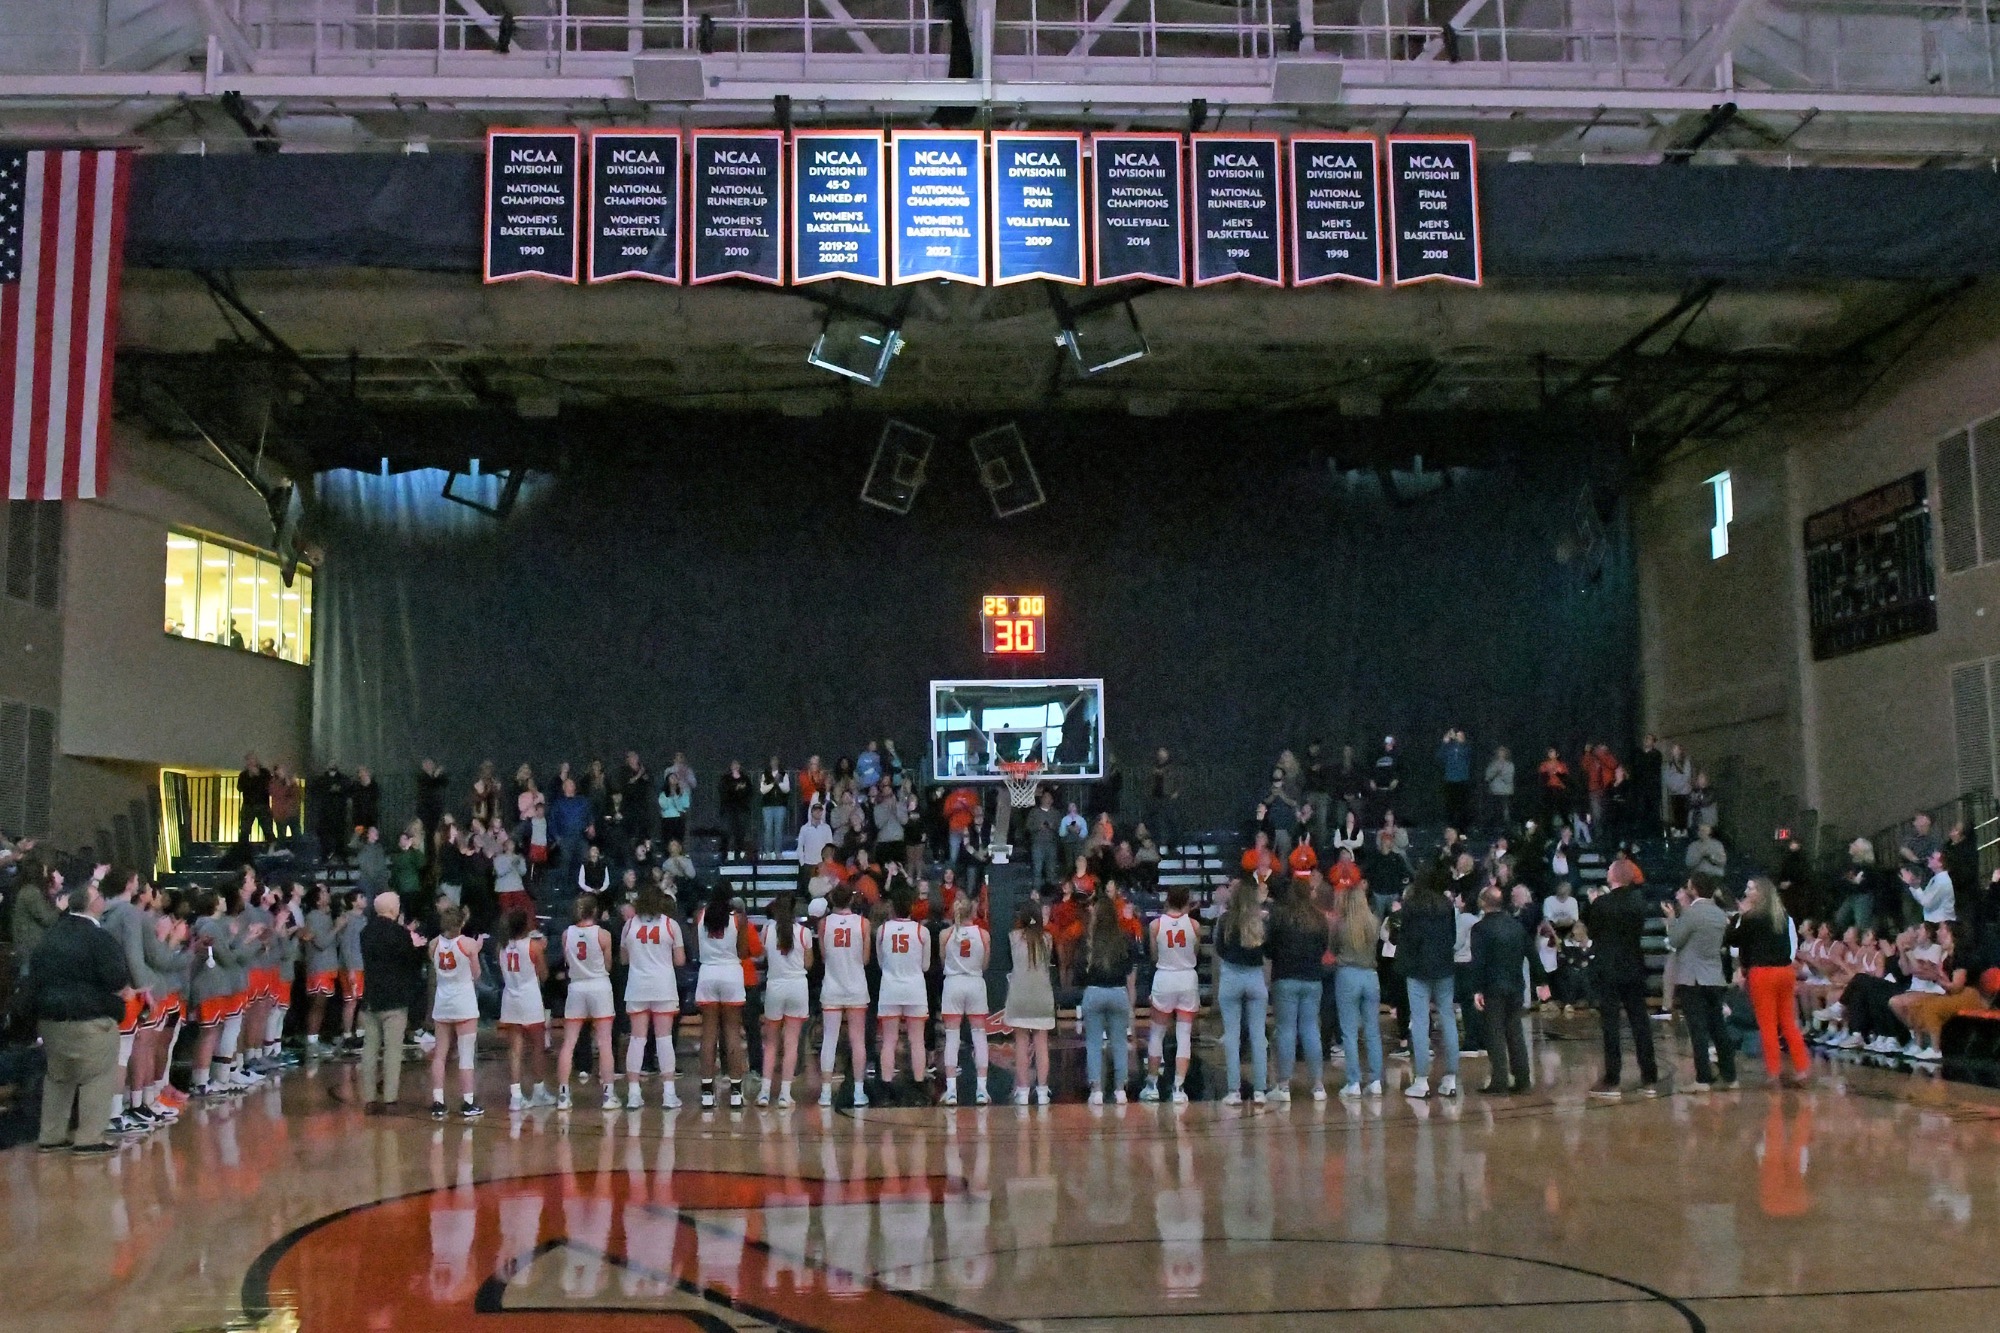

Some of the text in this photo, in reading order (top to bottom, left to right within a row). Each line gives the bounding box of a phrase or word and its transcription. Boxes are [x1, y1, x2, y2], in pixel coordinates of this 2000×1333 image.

[511, 150, 557, 162] NCAA
[613, 150, 659, 162] NCAA
[715, 151, 760, 163] NCAA
[816, 151, 861, 164] NCAA
[915, 151, 961, 165] NCAA
[1015, 153, 1060, 165] NCAA
[1115, 154, 1160, 166] NCAA
[1214, 154, 1258, 166] NCAA
[1312, 155, 1357, 167] NCAA
[1410, 156, 1455, 168] NCAA
[505, 165, 562, 173] DIVISION III
[607, 166, 664, 174] DIVISION III
[709, 167, 766, 175] DIVISION III
[809, 167, 867, 176] DIVISION III
[909, 167, 967, 176] DIVISION III
[1009, 168, 1066, 177] DIVISION III
[1109, 169, 1165, 177] DIVISION III
[1208, 170, 1264, 178] DIVISION III
[1307, 171, 1362, 179] DIVISION III
[1405, 171, 1460, 179] DIVISION III
[826, 180, 850, 189] 45-0
[507, 185, 560, 193] NATIONAL
[610, 185, 662, 193] NATIONAL
[711, 186, 764, 194] NATIONAL
[912, 185, 965, 195] NATIONAL
[1023, 187, 1053, 196] FINAL
[1112, 188, 1163, 196] NATIONAL
[1211, 189, 1262, 197] NATIONAL
[1310, 189, 1361, 197] NATIONAL
[1419, 190, 1447, 198] FINAL
[501, 196, 564, 204] CHAMPIONS
[604, 197, 667, 205] CHAMPIONS
[708, 197, 767, 206] RUNNER-UP
[810, 194, 867, 203] RANKED #1
[907, 197, 970, 206] CHAMPIONS
[1024, 198, 1052, 207] FOUR
[1107, 199, 1168, 208] CHAMPIONS
[1208, 200, 1266, 208] RUNNER-UP
[1307, 201, 1364, 209] RUNNER-UP
[1420, 201, 1447, 209] FOUR
[508, 215, 557, 223] WOMEN'S
[610, 216, 659, 224] WOMEN'S
[813, 212, 863, 221] WOMEN'S
[913, 216, 963, 225] WOMEN'S
[712, 217, 762, 225] WOMEN'S
[1007, 217, 1070, 226] VOLLEYBALL
[1107, 218, 1169, 226] VOLLEYBALL
[1223, 219, 1253, 227] MEN'S
[1322, 220, 1351, 228] MEN'S
[1420, 220, 1449, 228] MEN'S
[501, 227, 564, 235] BASKETBALL
[807, 223, 870, 232] BASKETBALL
[604, 228, 667, 236] BASKETBALL
[706, 228, 769, 237] BASKETBALL
[907, 227, 971, 237] BASKETBALL
[1207, 230, 1269, 238] BASKETBALL
[1306, 231, 1367, 239] BASKETBALL
[1404, 232, 1465, 240] BASKETBALL
[1025, 237, 1052, 245] 2009
[1127, 237, 1150, 245] 2014
[819, 242, 858, 250] 2019-20
[520, 247, 544, 255] 1990
[622, 247, 648, 255] 2006
[725, 247, 749, 256] 2010
[1227, 249, 1249, 257] 1996
[1326, 250, 1348, 258] 1998
[1423, 250, 1448, 258] 2008
[819, 253, 857, 262] 2020-21
[994, 620, 1034, 651] 30
[636, 926, 660, 944] 44
[833, 928, 851, 947] 21
[1166, 929, 1186, 948] 14
[892, 934, 909, 953] 15
[576, 941, 587, 960] 3
[960, 939, 971, 958] 2
[507, 953, 520, 972] 11
